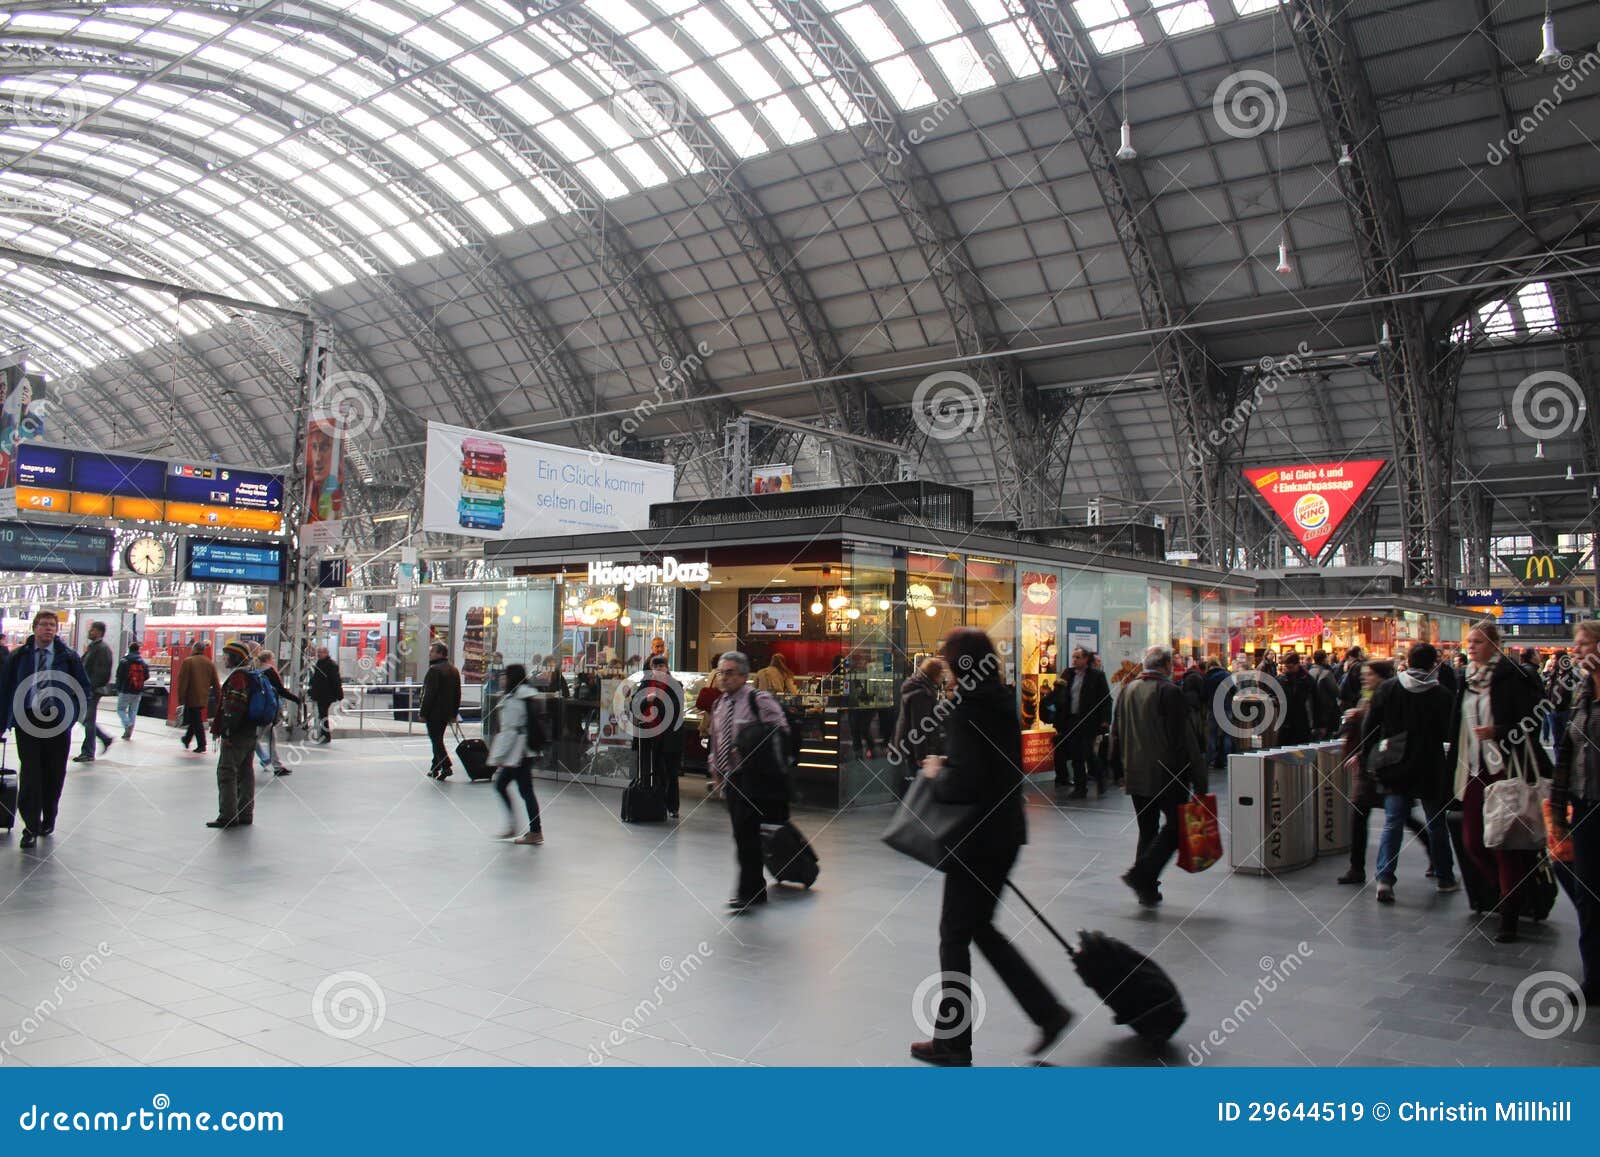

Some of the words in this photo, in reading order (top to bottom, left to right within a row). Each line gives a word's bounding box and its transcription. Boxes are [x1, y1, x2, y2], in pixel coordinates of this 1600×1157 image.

[538, 460, 557, 481] Ein
[562, 463, 601, 488] Glück
[604, 472, 645, 495] kommt
[1280, 471, 1294, 480] Bei
[1295, 469, 1317, 480] Gleis
[1318, 467, 1325, 478] 4
[1327, 467, 1344, 478] und
[1280, 480, 1354, 492] Einkaufspassage
[536, 492, 575, 511] selten
[579, 496, 616, 516] allein.
[1300, 506, 1325, 520] KING
[269, 550, 279, 561] 11
[588, 556, 710, 591] Häagen-Dazs
[1323, 785, 1334, 842] Abfall
[1271, 797, 1282, 859] Abfall
